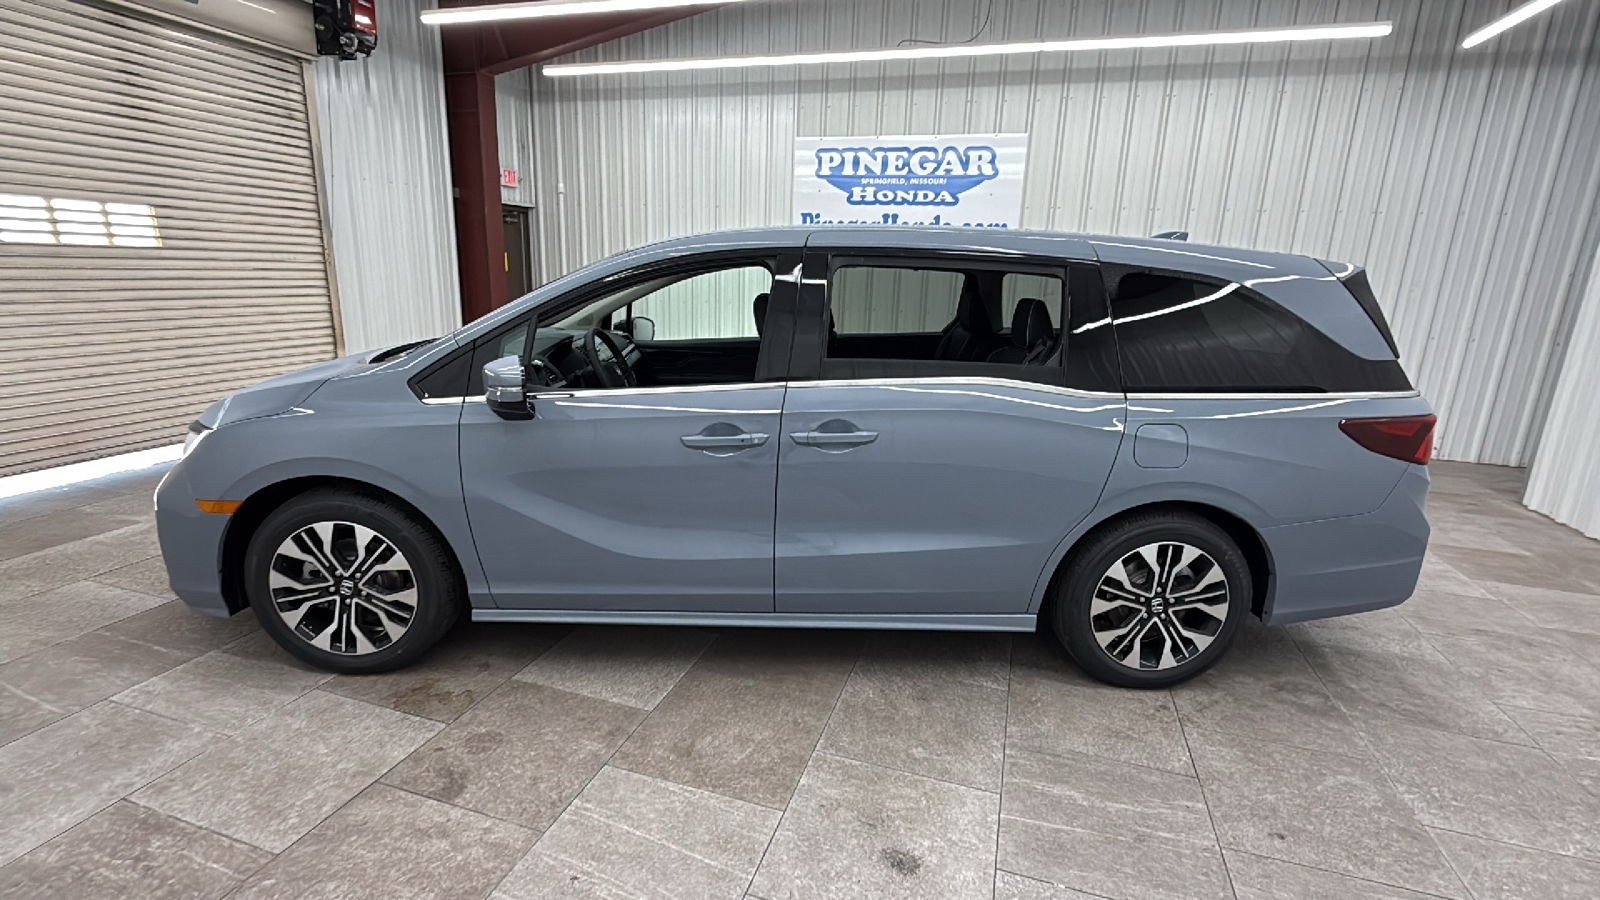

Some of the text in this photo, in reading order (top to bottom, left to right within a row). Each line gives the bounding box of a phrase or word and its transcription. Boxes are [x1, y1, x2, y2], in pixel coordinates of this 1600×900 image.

[818, 149, 996, 177] PINEGAR
[503, 168, 516, 184] EXIT
[861, 177, 948, 186] SPRINGFIELD, MISSOURI
[850, 186, 956, 203] HONDA
